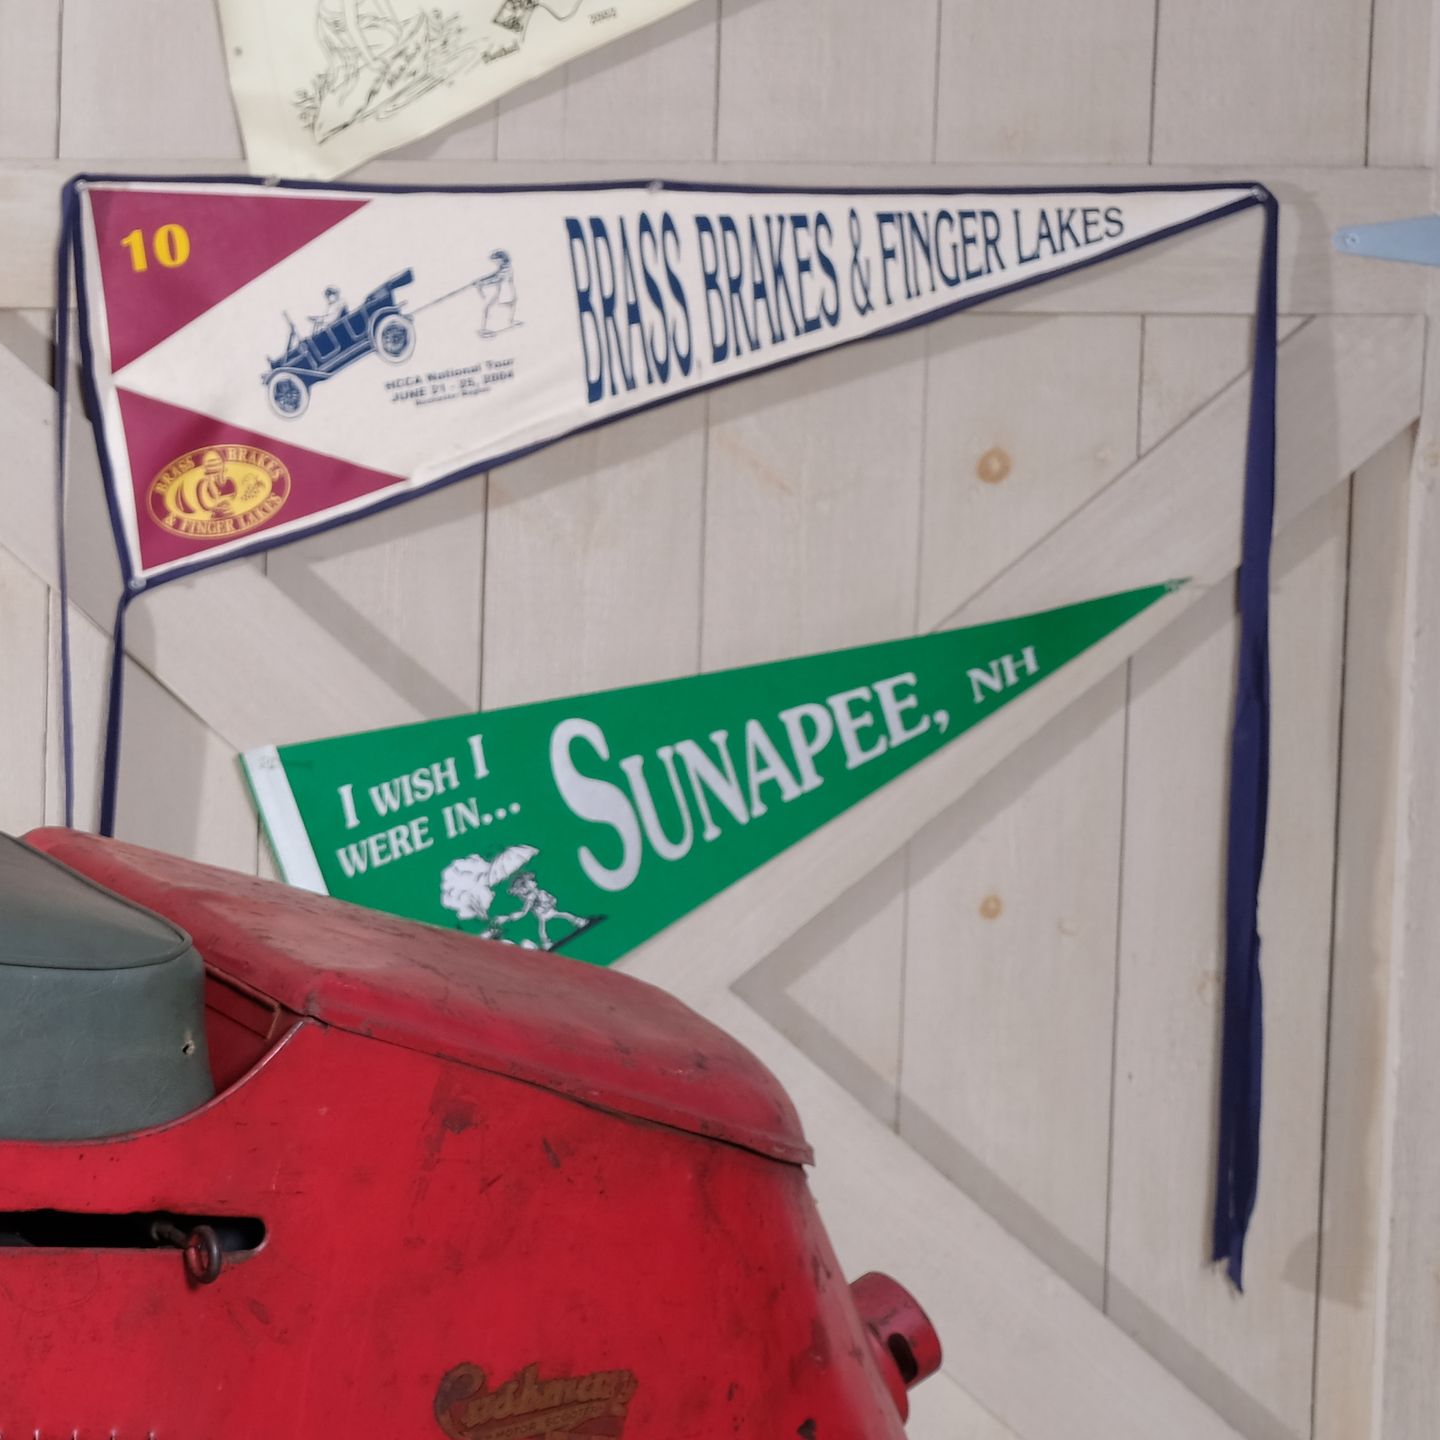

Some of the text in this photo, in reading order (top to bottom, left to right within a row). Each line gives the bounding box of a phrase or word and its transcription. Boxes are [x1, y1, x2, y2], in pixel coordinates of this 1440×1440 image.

[121, 223, 191, 273] 10
[563, 206, 1127, 404] BRASS BRAKES & FINGER LAKES
[228, 447, 282, 482] BRAKES
[180, 518, 235, 535] FINGER
[966, 646, 1041, 705] NH
[338, 735, 491, 830] I WISH I
[335, 799, 521, 879] WERE IN...
